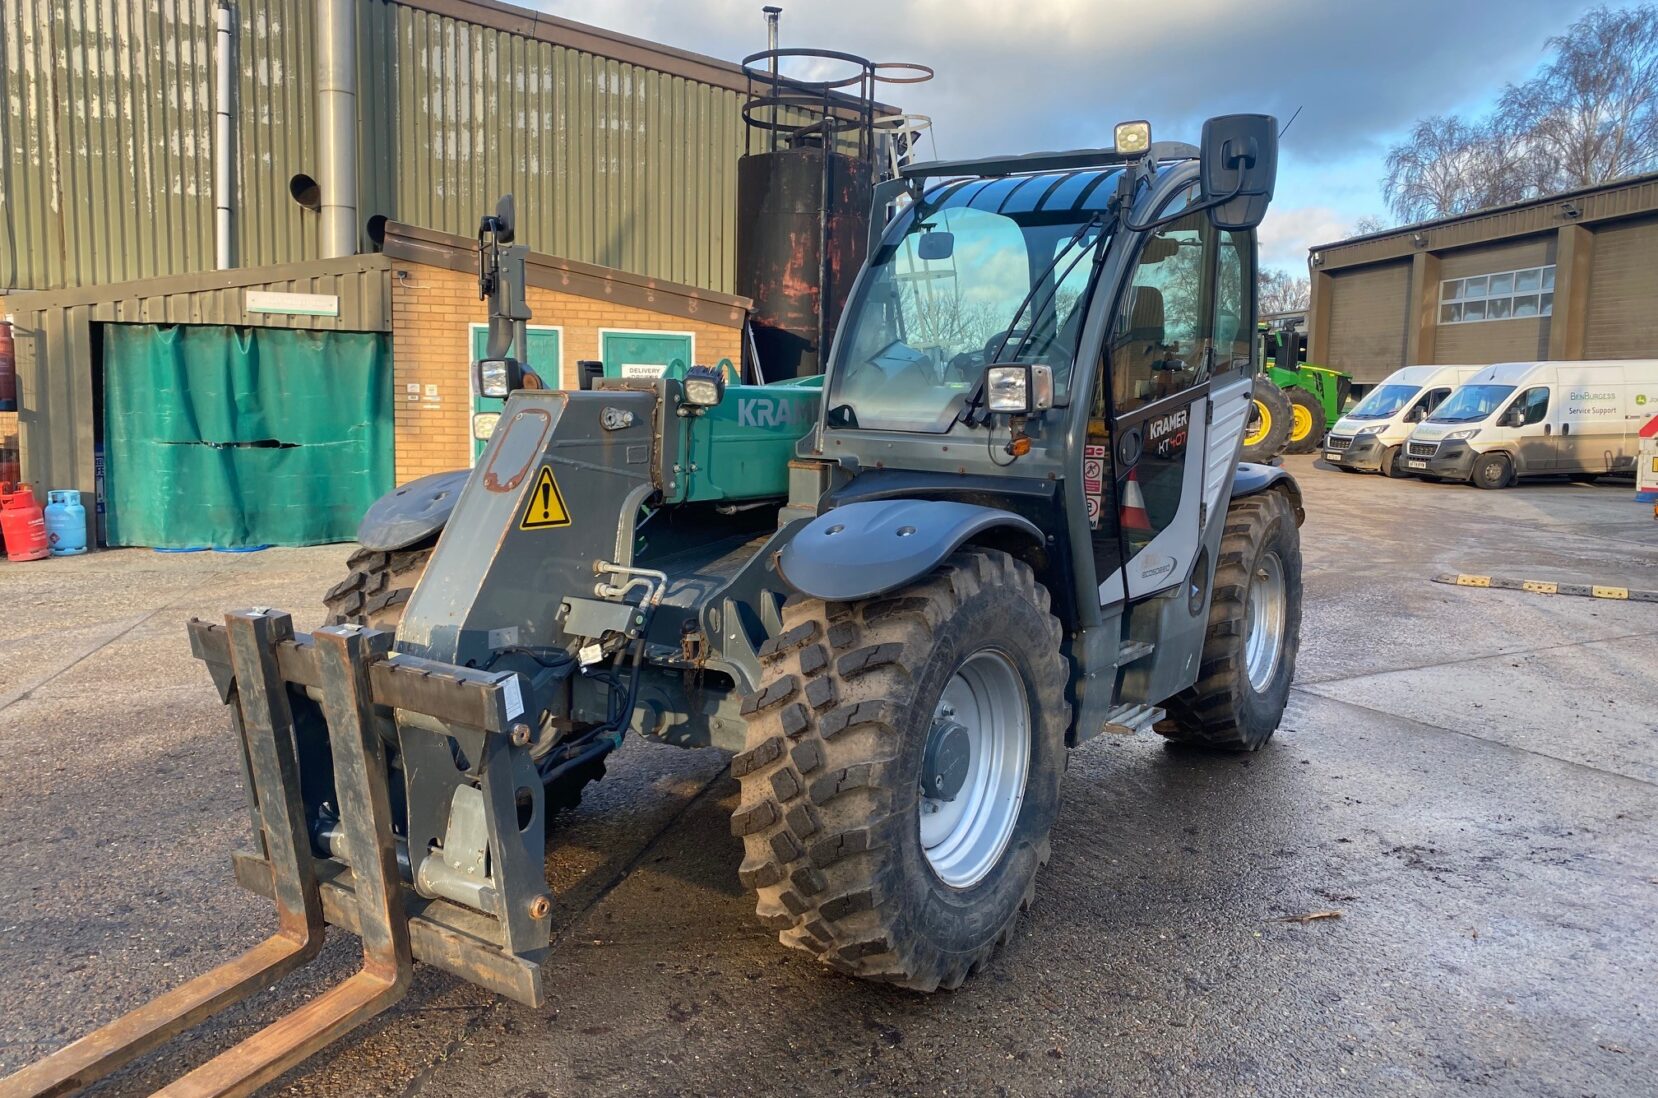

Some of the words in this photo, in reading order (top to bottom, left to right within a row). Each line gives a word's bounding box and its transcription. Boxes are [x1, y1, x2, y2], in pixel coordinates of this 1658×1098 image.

[738, 399, 816, 427] KRAM
[1150, 410, 1187, 440] KRAMER
[1569, 407, 1591, 415] Service
[1592, 406, 1617, 416] Support
